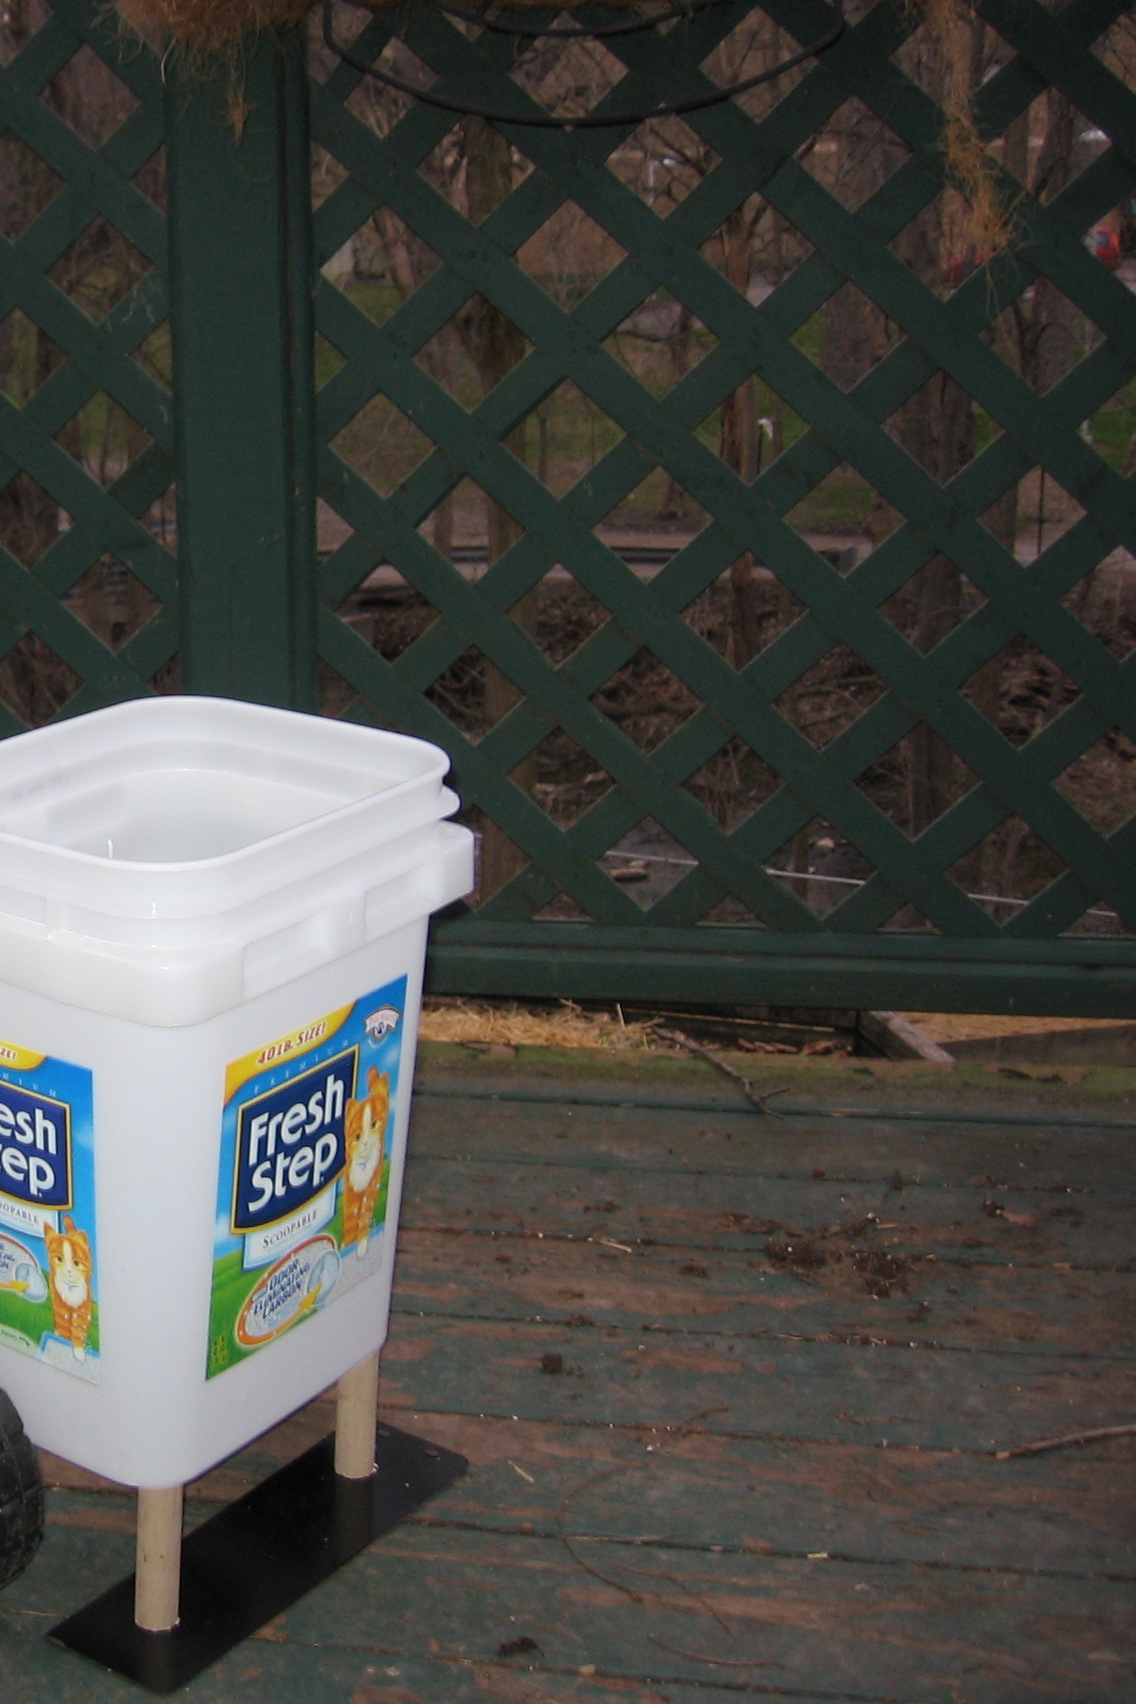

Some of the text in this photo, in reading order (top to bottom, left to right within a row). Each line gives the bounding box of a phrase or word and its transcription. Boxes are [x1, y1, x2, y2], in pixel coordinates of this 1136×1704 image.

[257, 1022, 327, 1064] 40 LB. SIZE!
[249, 1073, 344, 1167] Fresh
[247, 1133, 338, 1212] Step
[263, 1209, 318, 1249] SCOOPABLE
[269, 1258, 299, 1290] ODOR
